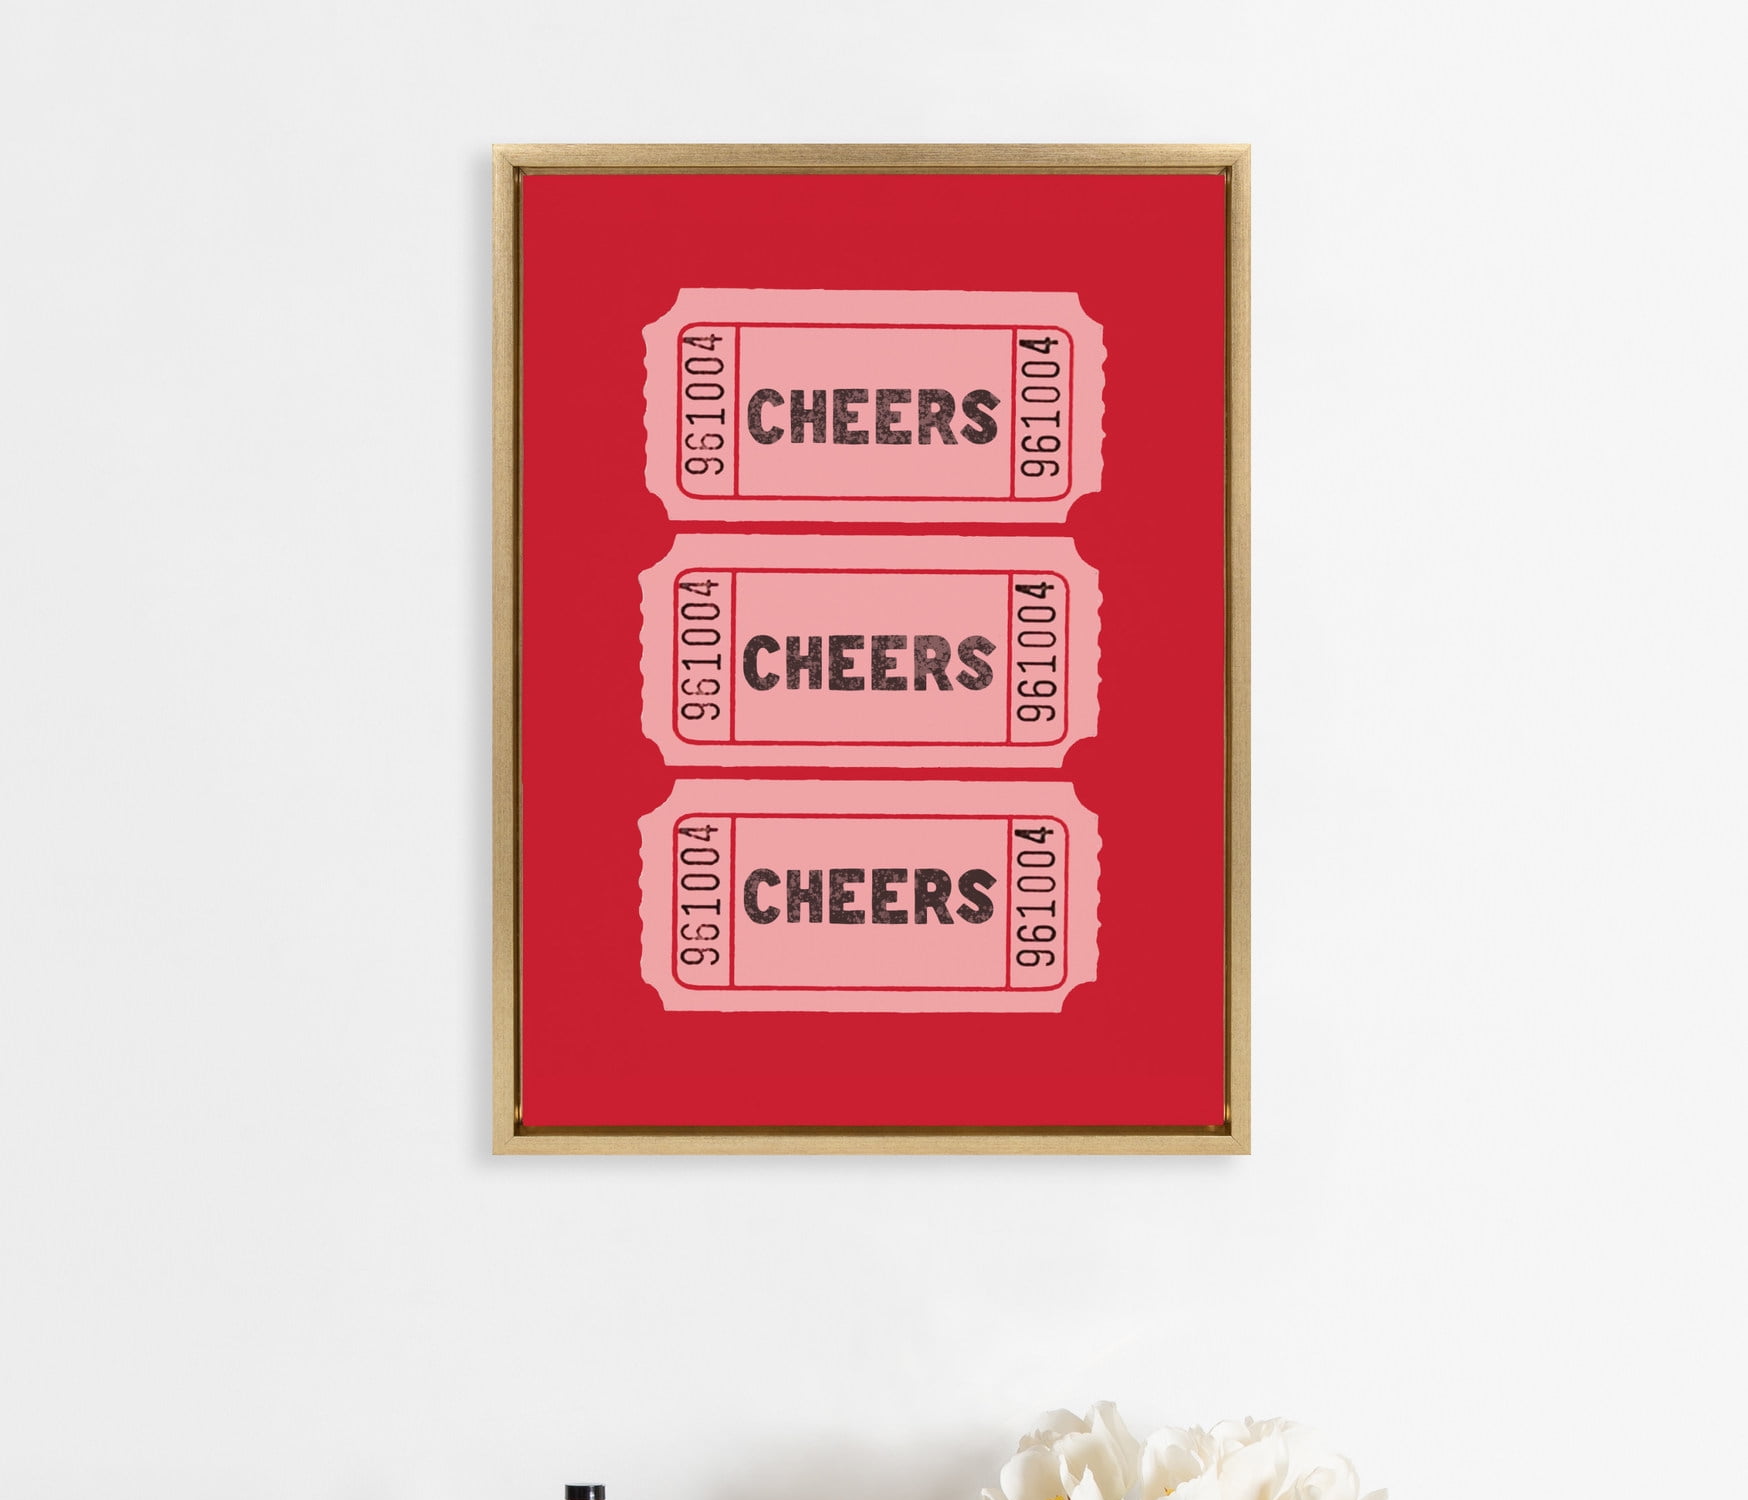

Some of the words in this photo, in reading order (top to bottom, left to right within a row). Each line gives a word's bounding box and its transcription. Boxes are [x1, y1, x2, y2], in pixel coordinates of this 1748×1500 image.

[683, 333, 726, 476] 961004
[747, 388, 1001, 445] CHEERS
[1019, 336, 1061, 477] 961004
[679, 579, 722, 721] 961004
[742, 634, 997, 691] CHEERS
[1015, 581, 1058, 722] 961004
[678, 824, 722, 966] 961004
[743, 868, 997, 925] CHEERS
[1014, 826, 1057, 967] 961004
